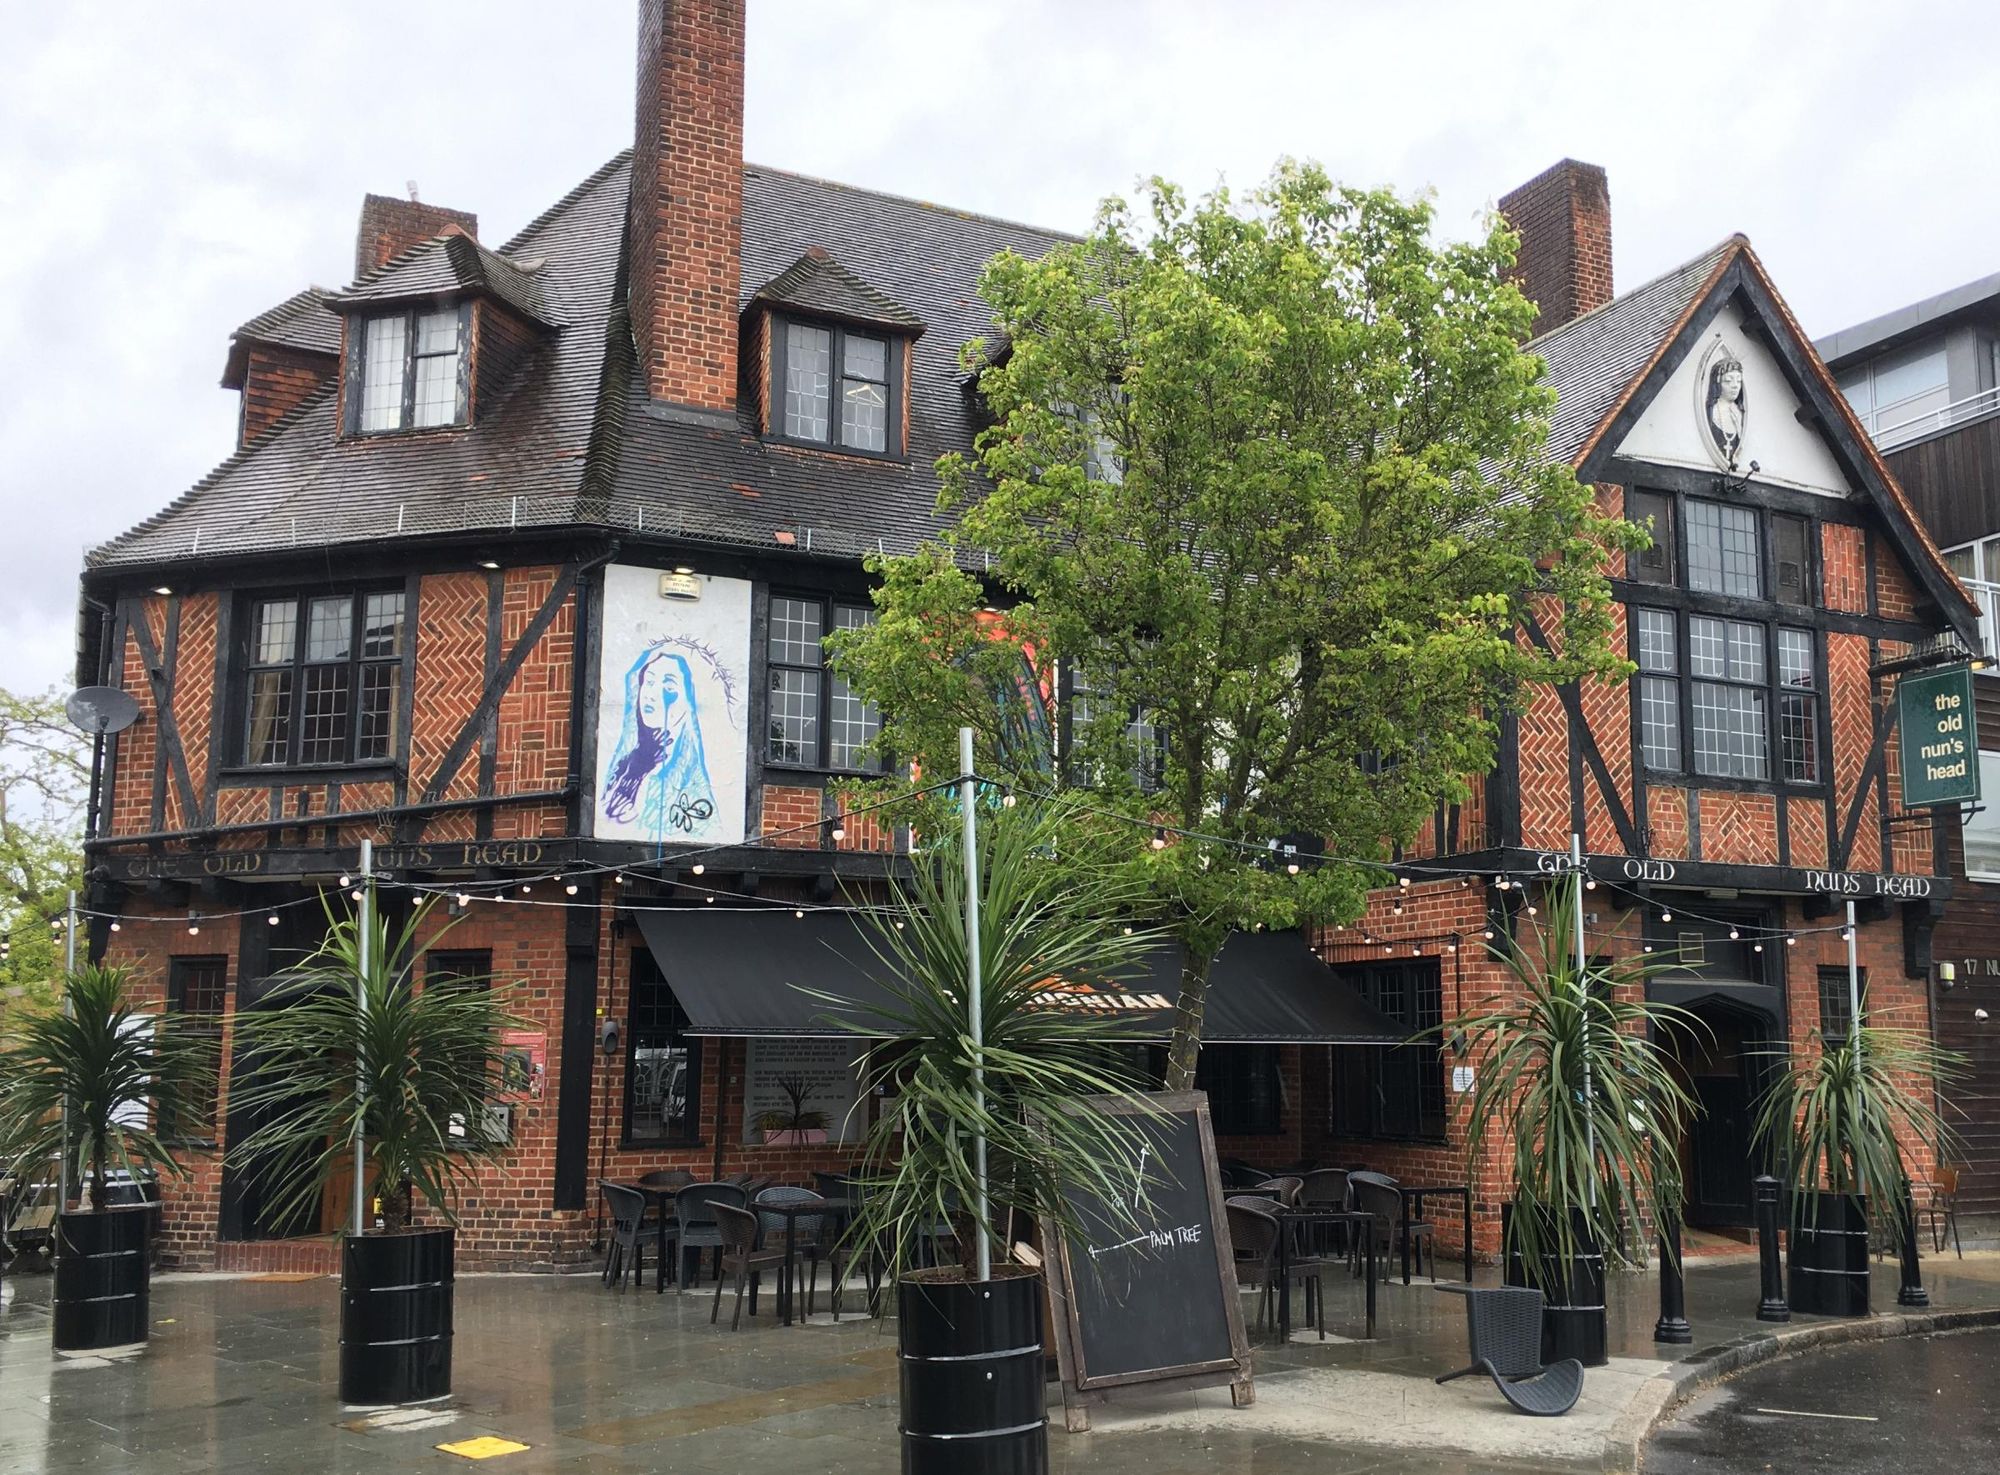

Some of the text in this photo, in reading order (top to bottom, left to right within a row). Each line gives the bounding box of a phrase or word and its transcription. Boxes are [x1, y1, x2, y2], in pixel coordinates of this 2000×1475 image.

[1935, 693, 1960, 711] the
[1937, 713, 1963, 734] old
[1921, 737, 1965, 759] nun's
[1926, 758, 1967, 781] head
[203, 853, 261, 875] OLD
[1623, 858, 1675, 882] OLD
[1963, 958, 1978, 975] 17
[1149, 1223, 1202, 1249] PALM TREE
